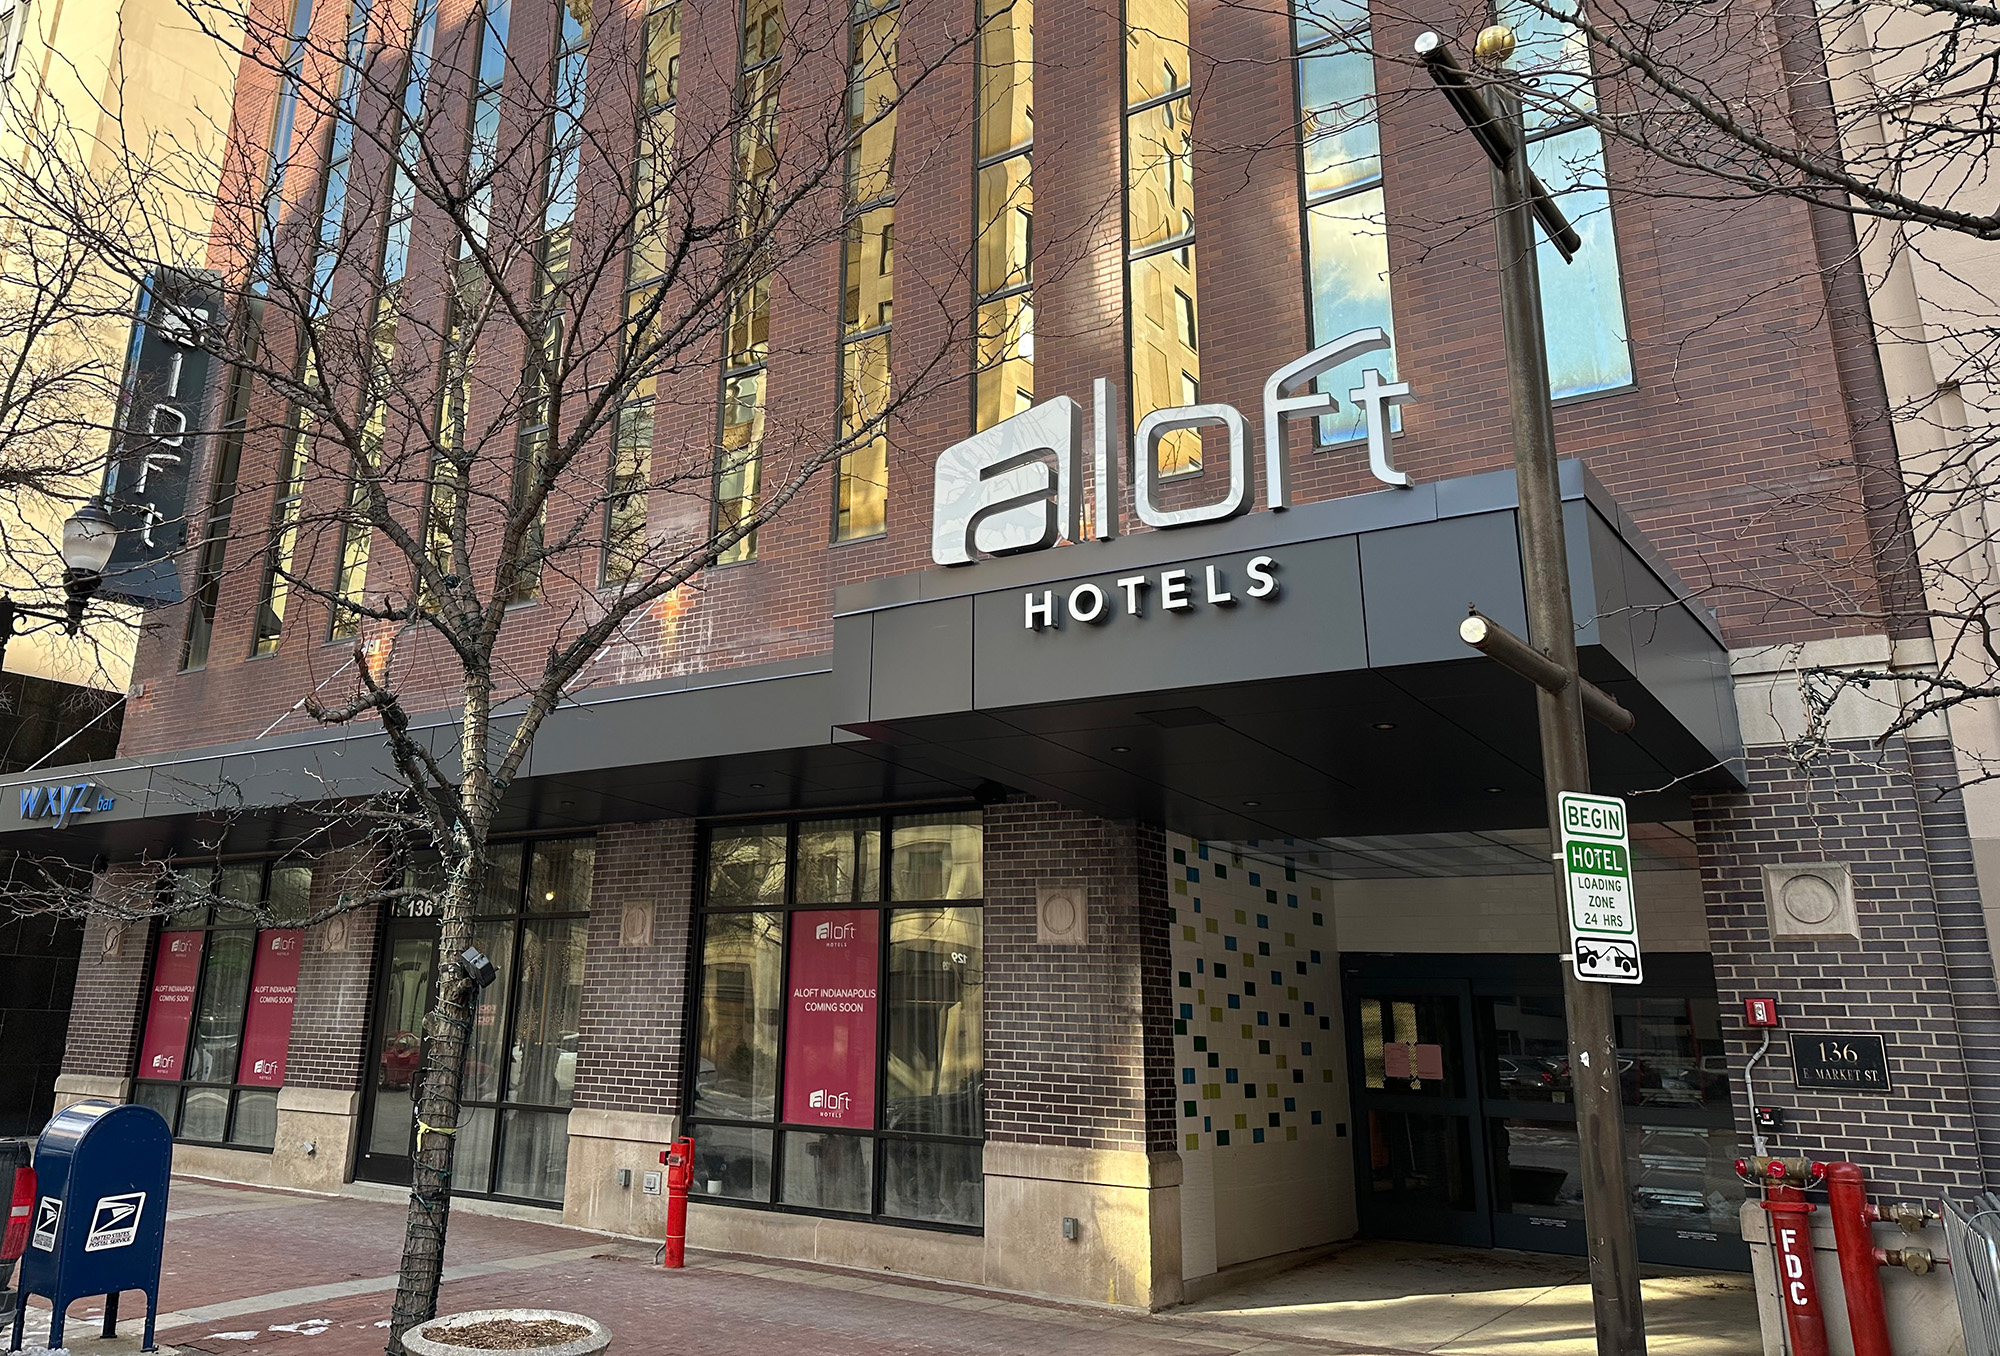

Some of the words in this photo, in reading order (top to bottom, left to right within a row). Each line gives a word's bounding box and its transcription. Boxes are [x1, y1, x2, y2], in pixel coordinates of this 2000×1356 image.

[932, 327, 1417, 566] aloft
[1023, 555, 1280, 632] HOTELS
[97, 794, 115, 811] bar
[1568, 805, 1620, 831] BEGIN
[1572, 846, 1623, 872] HOTEL
[1578, 876, 1622, 892] LOADING
[407, 899, 434, 917] 136
[1588, 895, 1615, 909] ZONE
[1584, 913, 1598, 926] 24
[1603, 914, 1623, 927] HRS
[815, 921, 857, 940] aloft
[254, 985, 269, 993] ALOFT
[794, 988, 819, 998] ALOFT
[820, 988, 876, 999] INDIANAPOLIS
[259, 996, 278, 1004] COMING
[279, 996, 293, 1004] SOON
[805, 1002, 838, 1012] COMING
[839, 1002, 864, 1013] SOON
[1819, 1041, 1858, 1063] 136
[1803, 1067, 1812, 1079] E.
[1815, 1067, 1860, 1081] MARKET
[1864, 1069, 1880, 1082] ST.
[809, 1089, 852, 1110] aloft
[820, 1111, 842, 1119] HOTELS
[89, 1240, 109, 1248] POSTAL
[110, 1236, 131, 1244] SERVICE
[91, 1233, 111, 1242] UNITED
[111, 1230, 130, 1239] STATES
[1781, 1229, 1808, 1306] FDC
